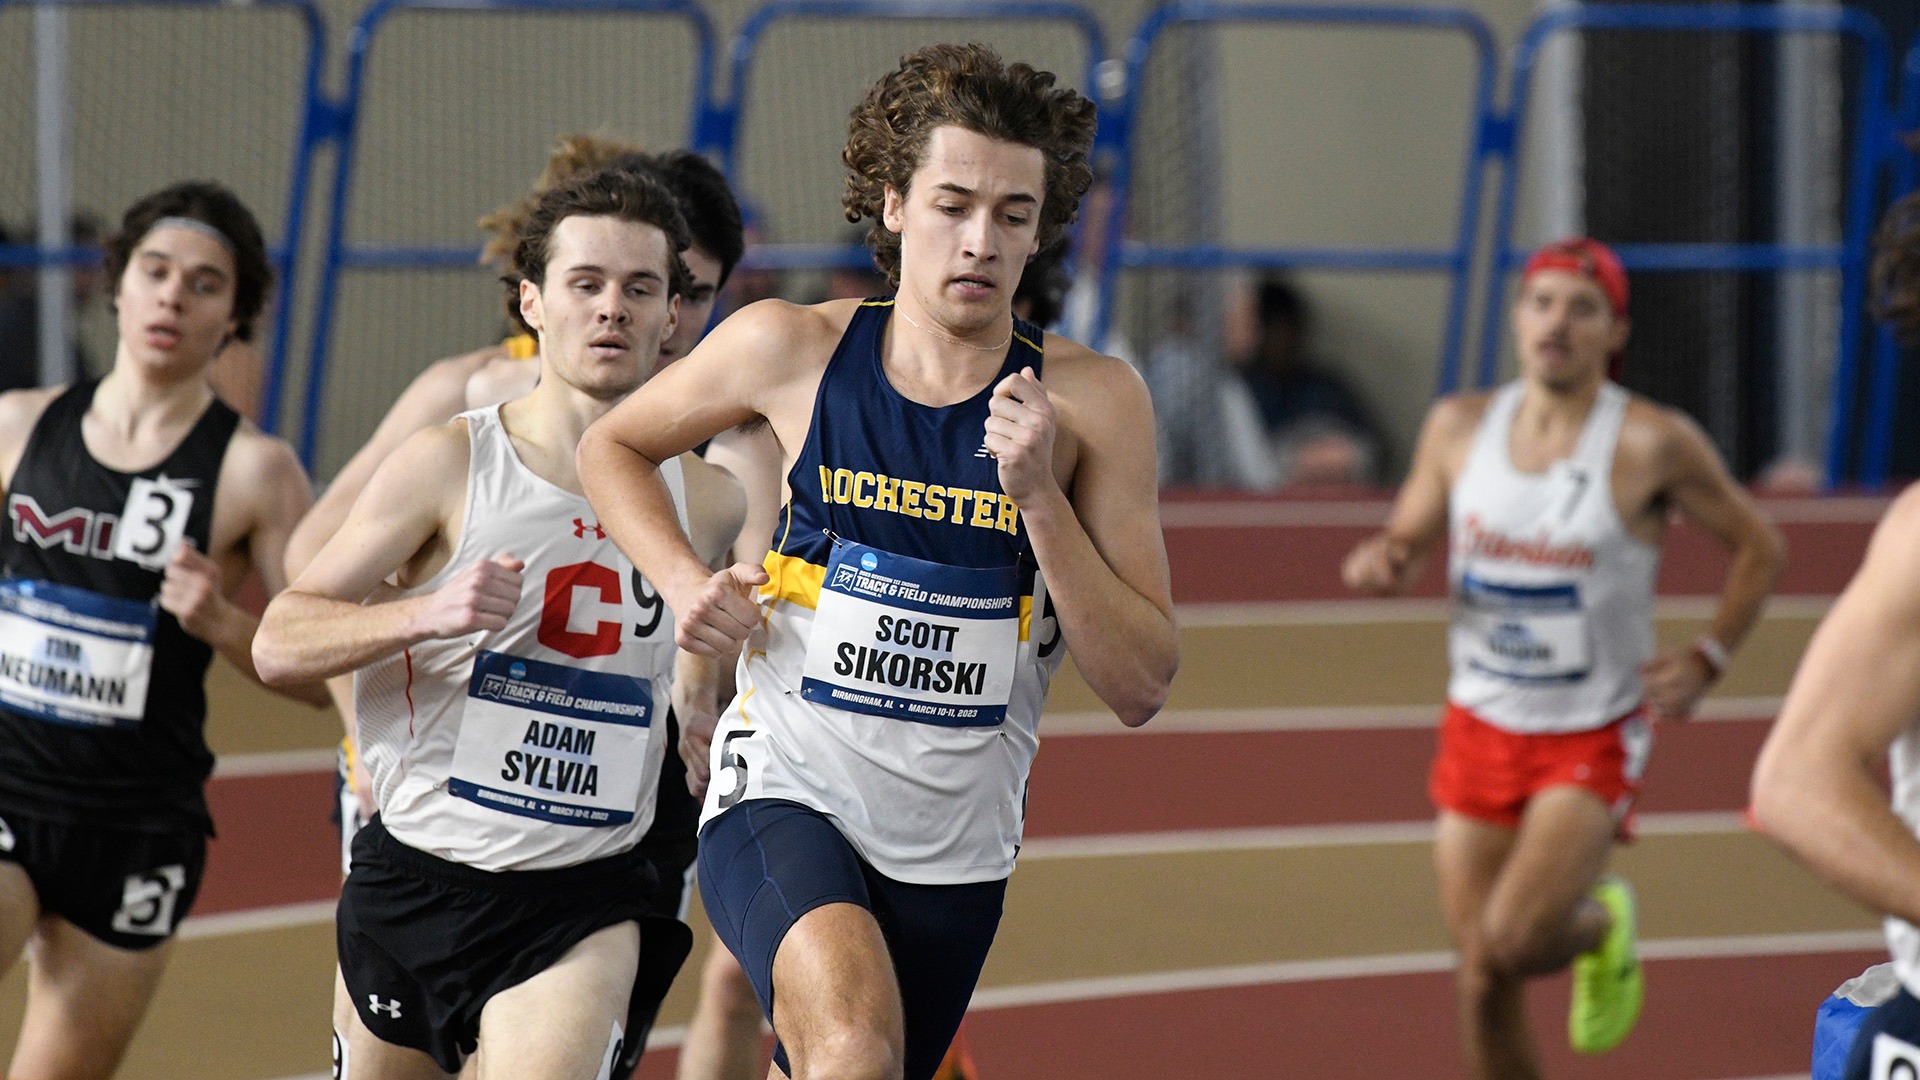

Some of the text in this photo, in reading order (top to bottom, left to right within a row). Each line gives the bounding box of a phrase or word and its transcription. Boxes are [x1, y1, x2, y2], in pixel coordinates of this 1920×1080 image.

[132, 491, 175, 556] 3
[537, 560, 623, 659] C
[631, 566, 665, 638] 9
[855, 575, 889, 595] TRACK
[888, 584, 898, 596] &
[897, 586, 928, 603] FIELD
[928, 593, 1013, 610] CHAMPIONSHIPS
[875, 615, 960, 652] SCOTT
[0, 653, 127, 706] NEUMANN
[834, 641, 987, 695] SIKORSKI
[504, 683, 537, 701] TRACK
[536, 690, 546, 702] &
[545, 691, 574, 708] FIELD
[574, 698, 646, 718] CHAMPIONSHIPS
[831, 688, 978, 718] BIRMINGHAM, AL MARCH 10-11, 2023
[523, 719, 596, 756] ADAM
[501, 750, 598, 797] SYLVIA
[718, 730, 757, 809] 5
